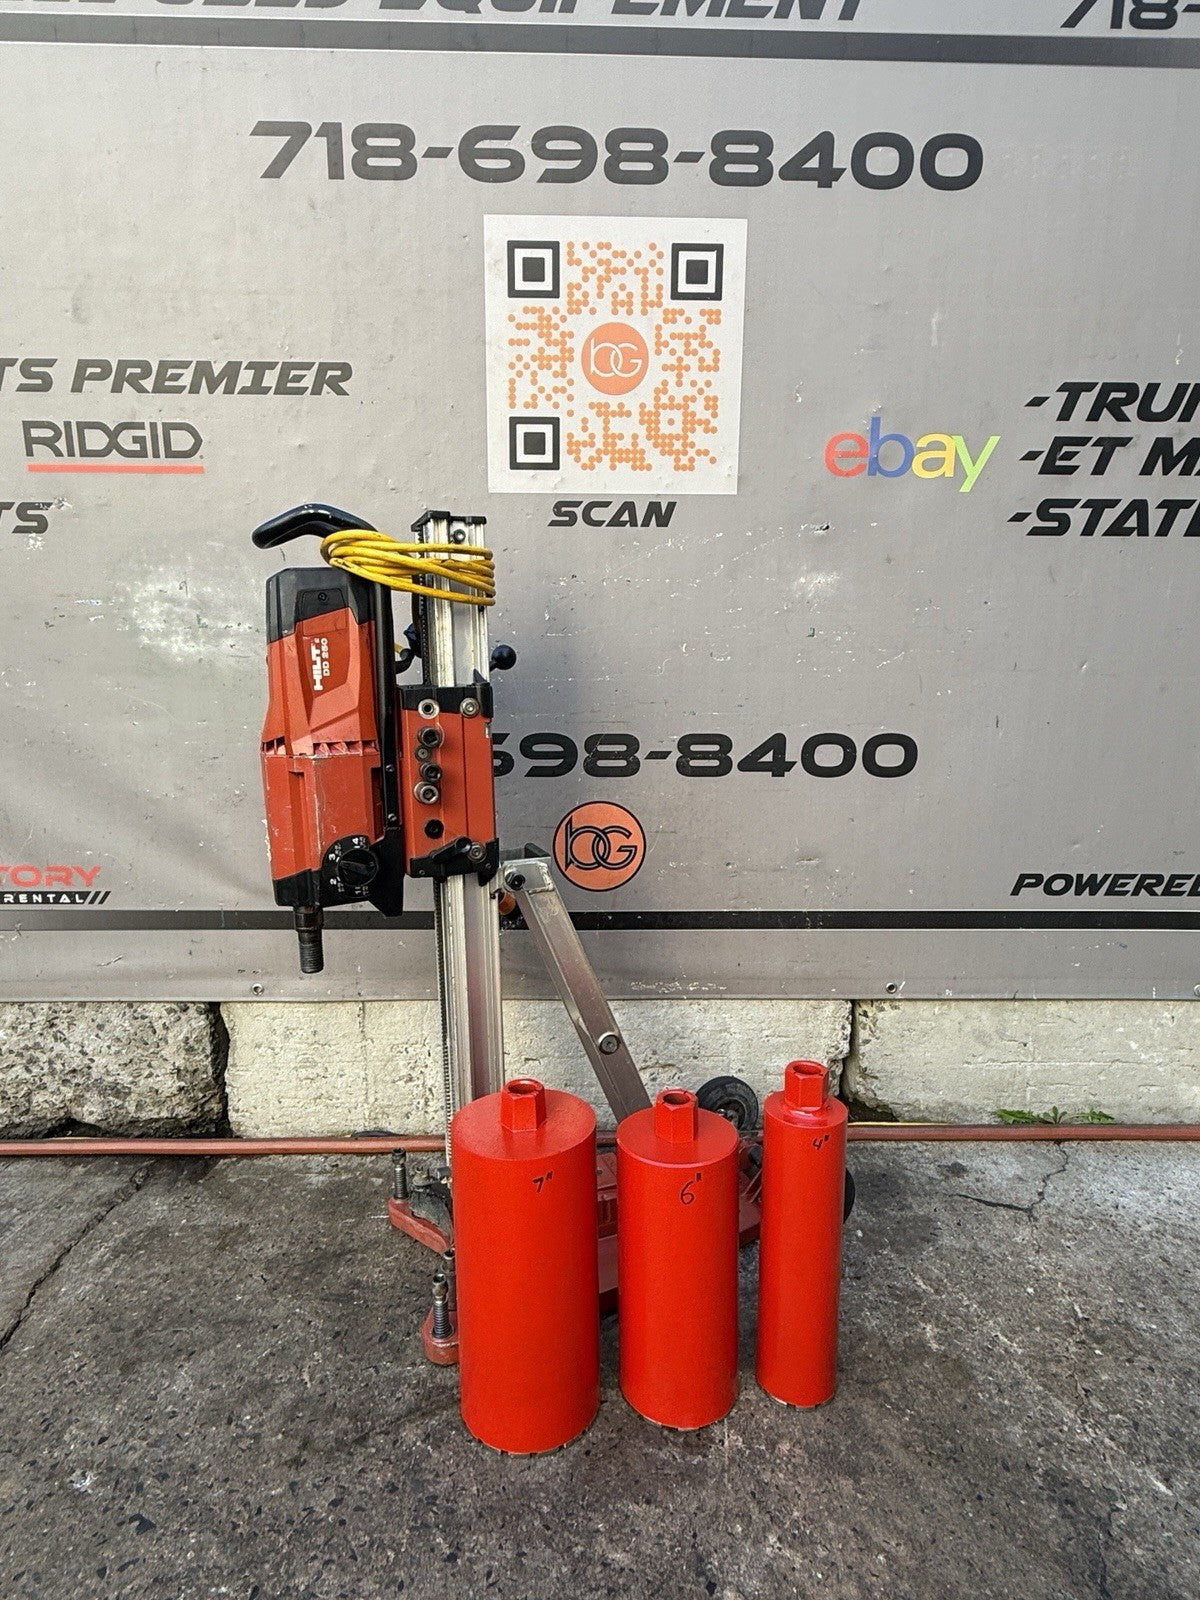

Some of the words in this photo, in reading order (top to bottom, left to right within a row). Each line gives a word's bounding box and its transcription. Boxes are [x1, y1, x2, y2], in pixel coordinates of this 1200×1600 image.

[250, 120, 984, 190] 718-698-8400
[70, 358, 353, 396] PREMIER
[22, 420, 203, 459] RIDGID
[824, 416, 1001, 493] ebay
[1138, 437, 1200, 477] M
[547, 500, 677, 528] SCAN
[3, 893, 84, 903] RENTAL
